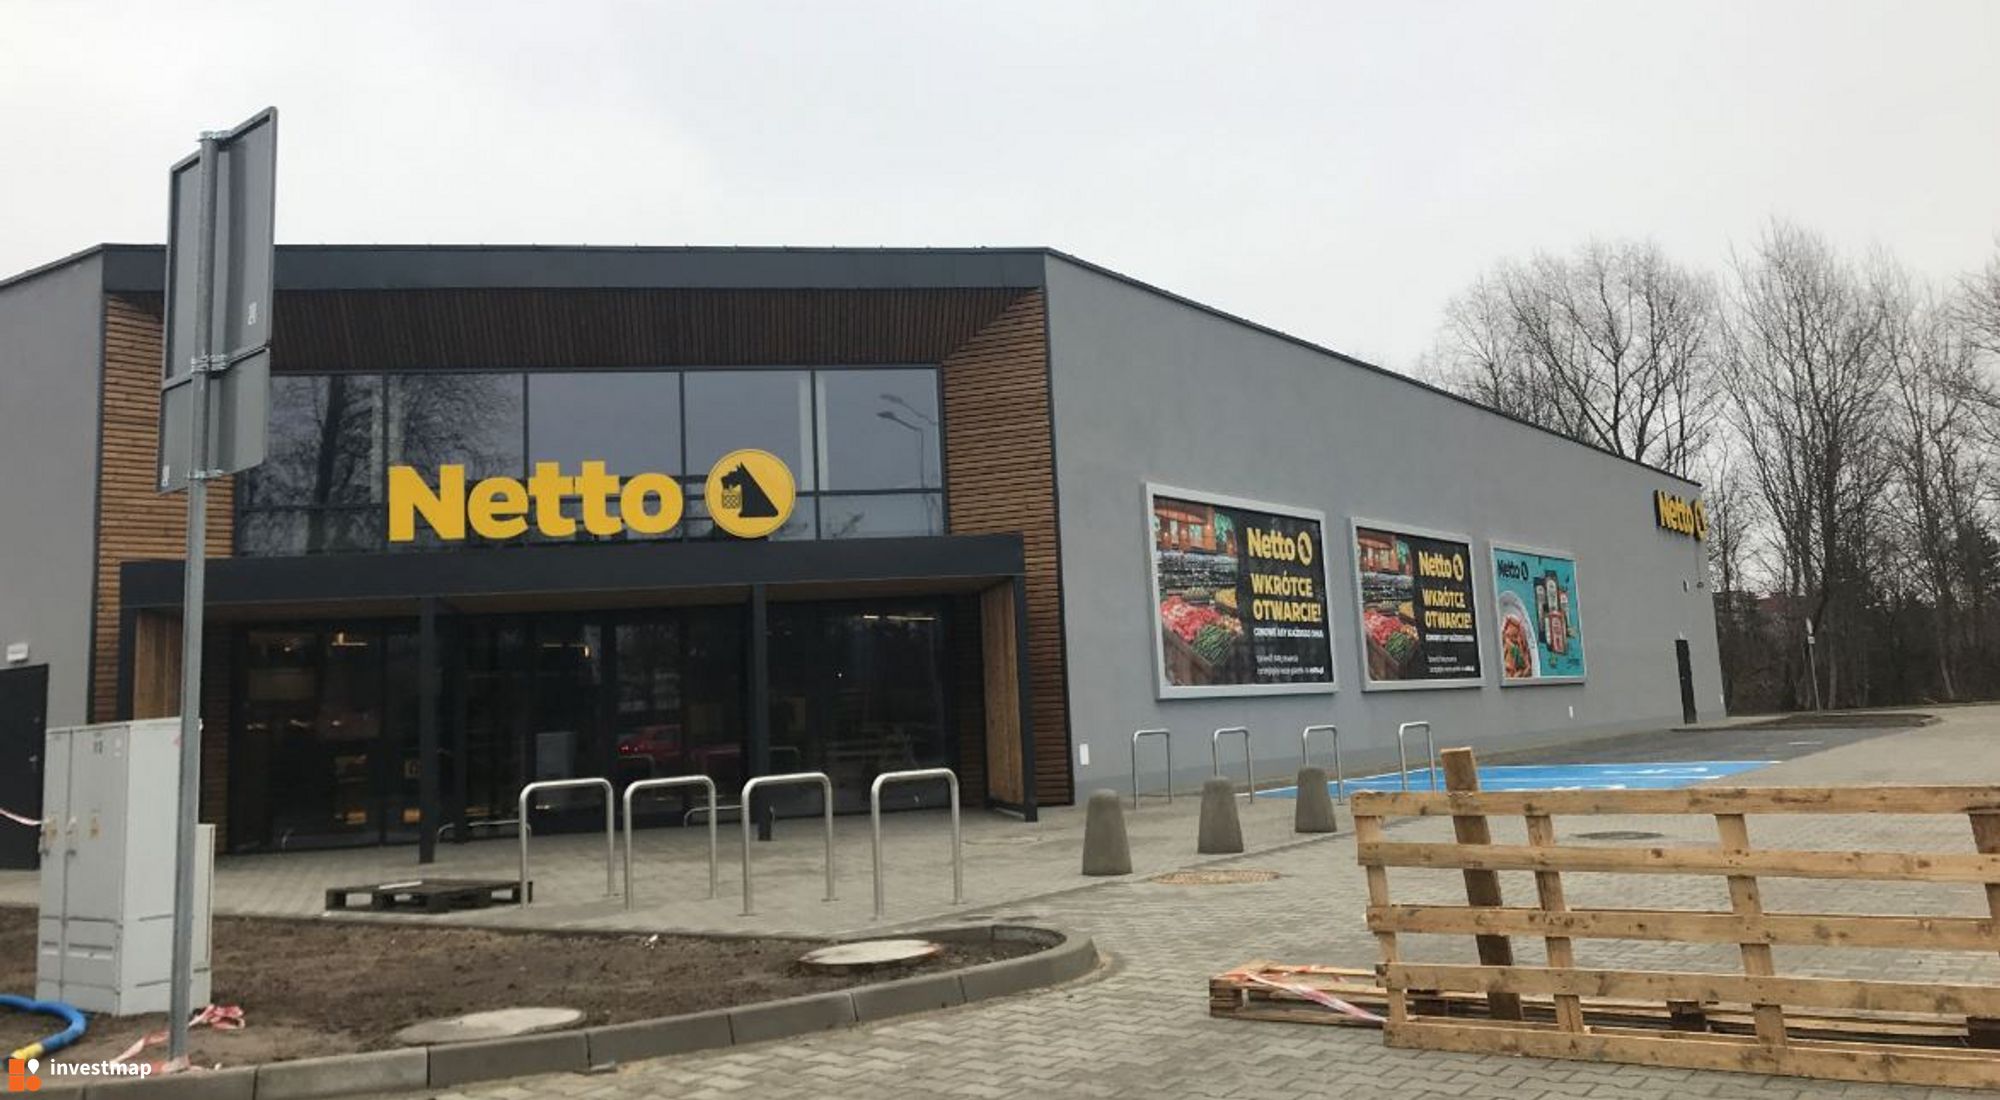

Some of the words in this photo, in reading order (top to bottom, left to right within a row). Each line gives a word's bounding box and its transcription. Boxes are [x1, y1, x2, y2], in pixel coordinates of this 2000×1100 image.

[388, 460, 684, 542] Netto
[1655, 489, 1694, 536] Netto
[1246, 527, 1296, 561] Netto
[1418, 550, 1452, 578] Netto
[1496, 559, 1520, 580] Netto
[1250, 569, 1313, 598] WKRÓTCE
[1422, 585, 1466, 609] WKRÓTCE
[1253, 598, 1322, 622] OTWARCIE!
